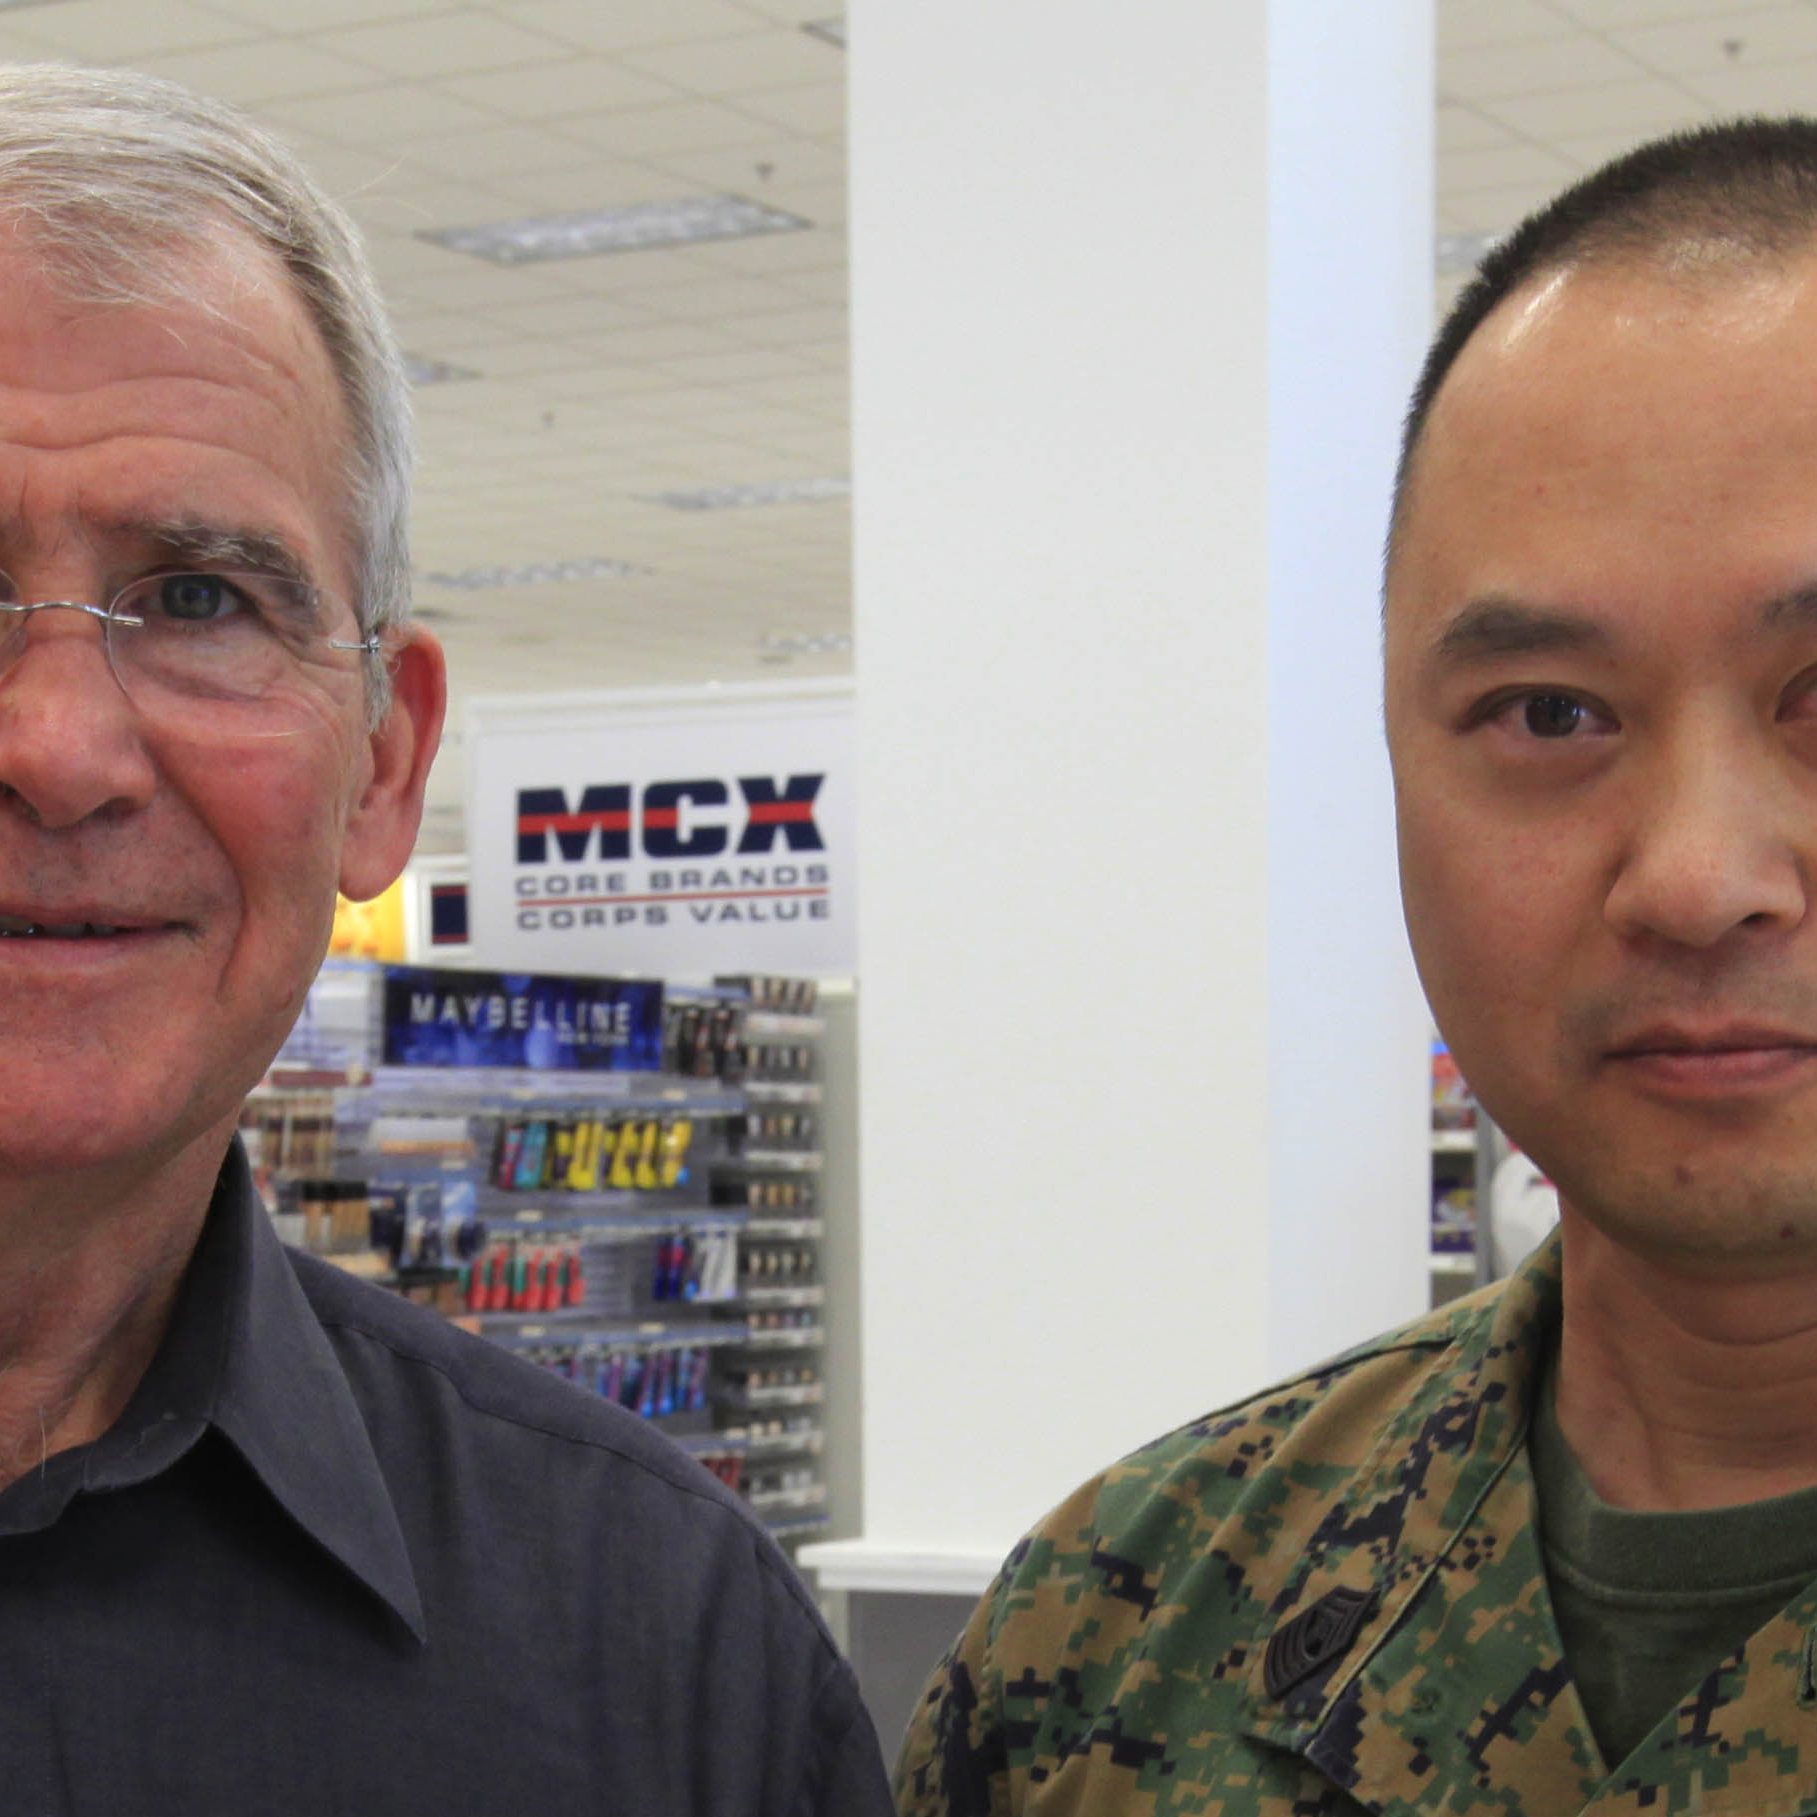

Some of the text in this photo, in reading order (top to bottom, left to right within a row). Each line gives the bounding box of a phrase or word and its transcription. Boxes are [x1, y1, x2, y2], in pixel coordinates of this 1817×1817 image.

[516, 774, 827, 864] MCX
[515, 864, 829, 898] CORE BRANDS
[515, 898, 831, 931] CORPS VALUE
[409, 994, 632, 1037] MAYBELLINE
